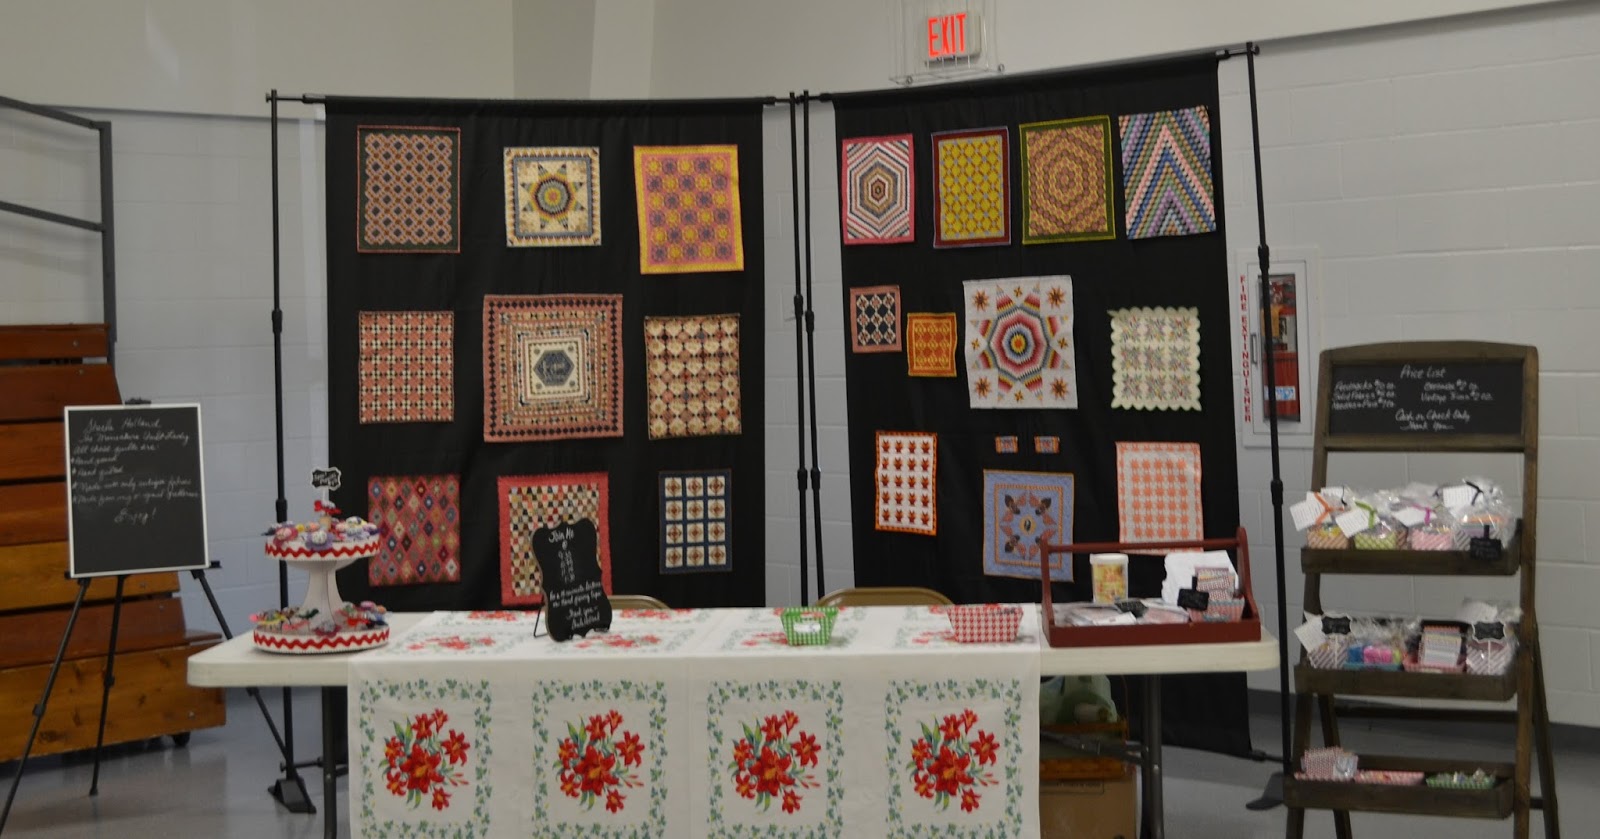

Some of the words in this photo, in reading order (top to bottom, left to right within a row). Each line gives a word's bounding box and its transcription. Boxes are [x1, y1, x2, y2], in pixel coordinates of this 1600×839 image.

[928, 13, 967, 58] EXIT
[1241, 315, 1251, 422] EXTINGUISHER
[1400, 364, 1424, 379] Price
[1427, 366, 1446, 379] List
[1395, 408, 1415, 421] Cash
[1415, 413, 1426, 421] or
[1426, 408, 1451, 421] Check
[1452, 408, 1471, 423] Only
[121, 417, 161, 430] Holland
[73, 445, 89, 455] All
[114, 442, 138, 456] quilts
[121, 477, 136, 492] only
[549, 530, 565, 543] Join
[566, 527, 574, 540] Me
